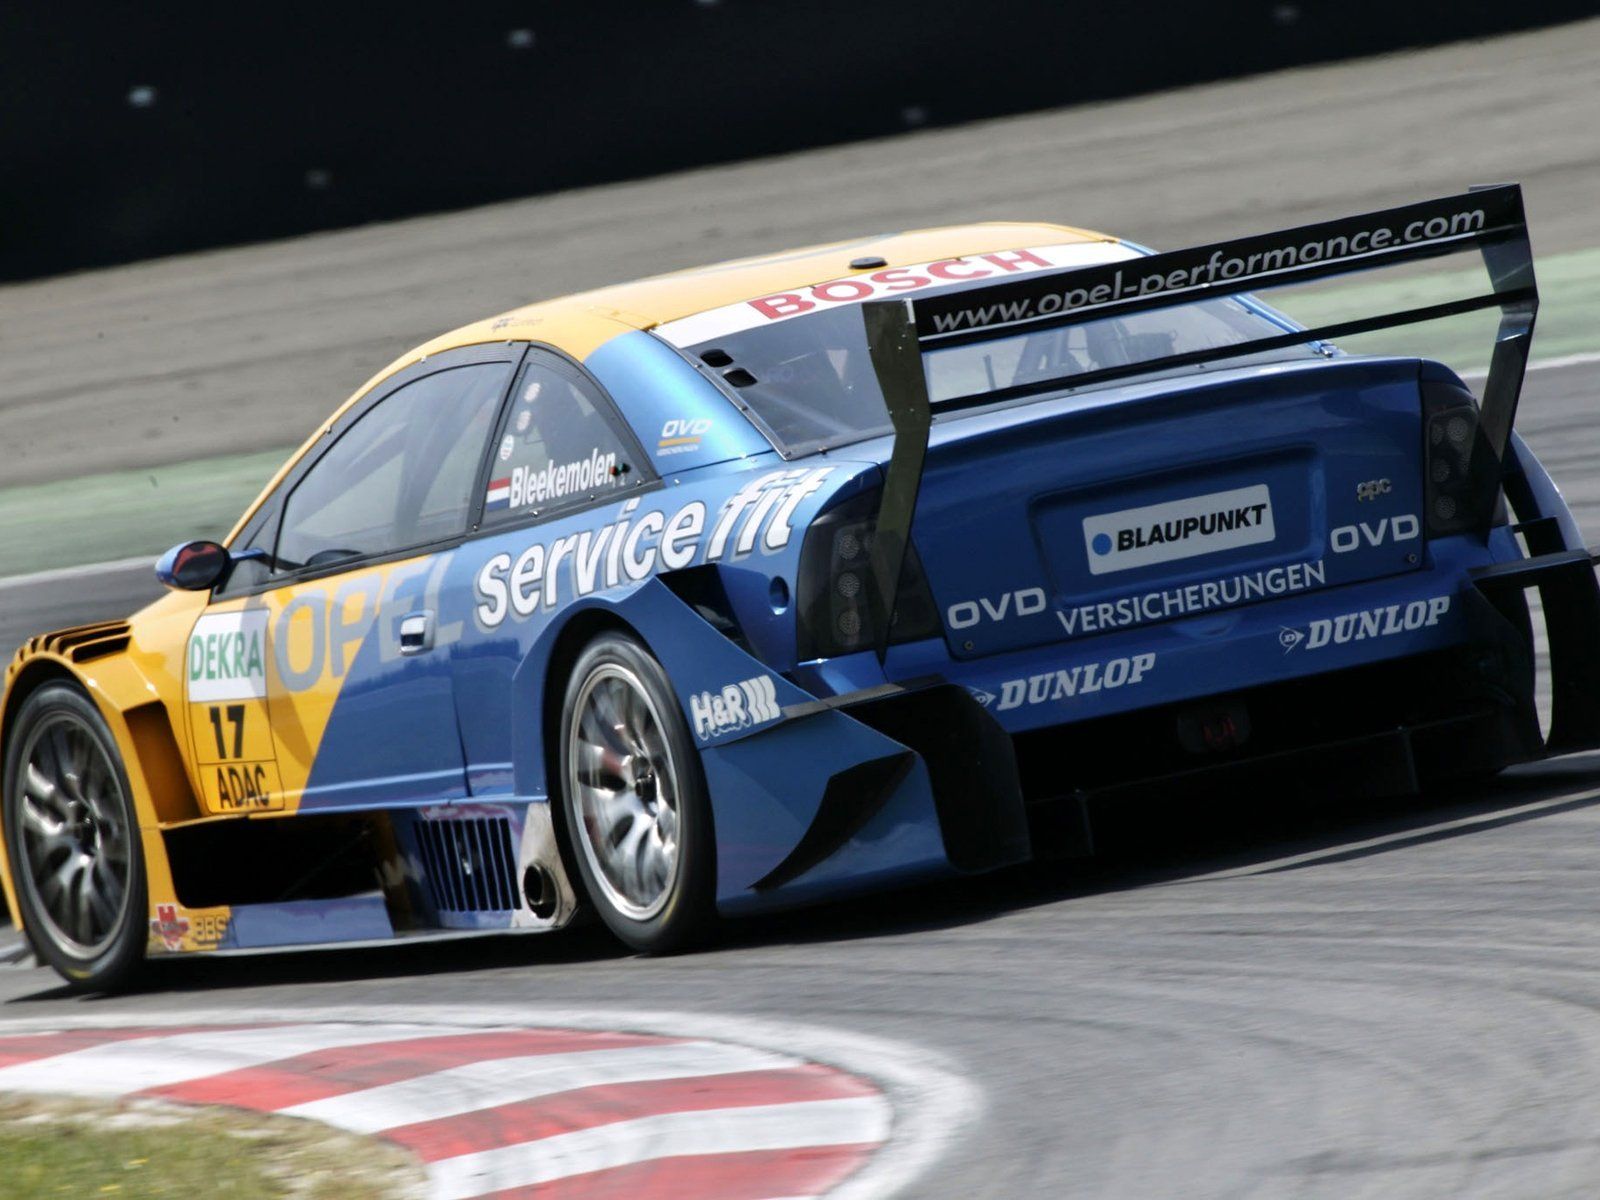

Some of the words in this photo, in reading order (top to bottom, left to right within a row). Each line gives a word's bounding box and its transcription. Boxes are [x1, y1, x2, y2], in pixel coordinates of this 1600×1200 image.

[747, 249, 1054, 320] BOSCH
[932, 208, 1486, 333] www.opel-performance.com
[661, 419, 712, 437] OVD
[509, 448, 616, 508] Bleekemolen
[475, 496, 706, 627] service
[706, 466, 834, 562] fit
[1117, 503, 1266, 552] BLAUPUNKT
[1330, 514, 1419, 553] OVD
[275, 552, 464, 693] OPEL
[947, 587, 1047, 630] OVD
[1056, 560, 1325, 635] VERSICHERUNGEN
[1305, 595, 1451, 650] DUNLOP
[190, 629, 263, 682] DEKRA
[997, 652, 1156, 711] DUNLOP
[209, 704, 245, 760] 17
[690, 684, 752, 740] H&R
[217, 764, 270, 810] ADAC
